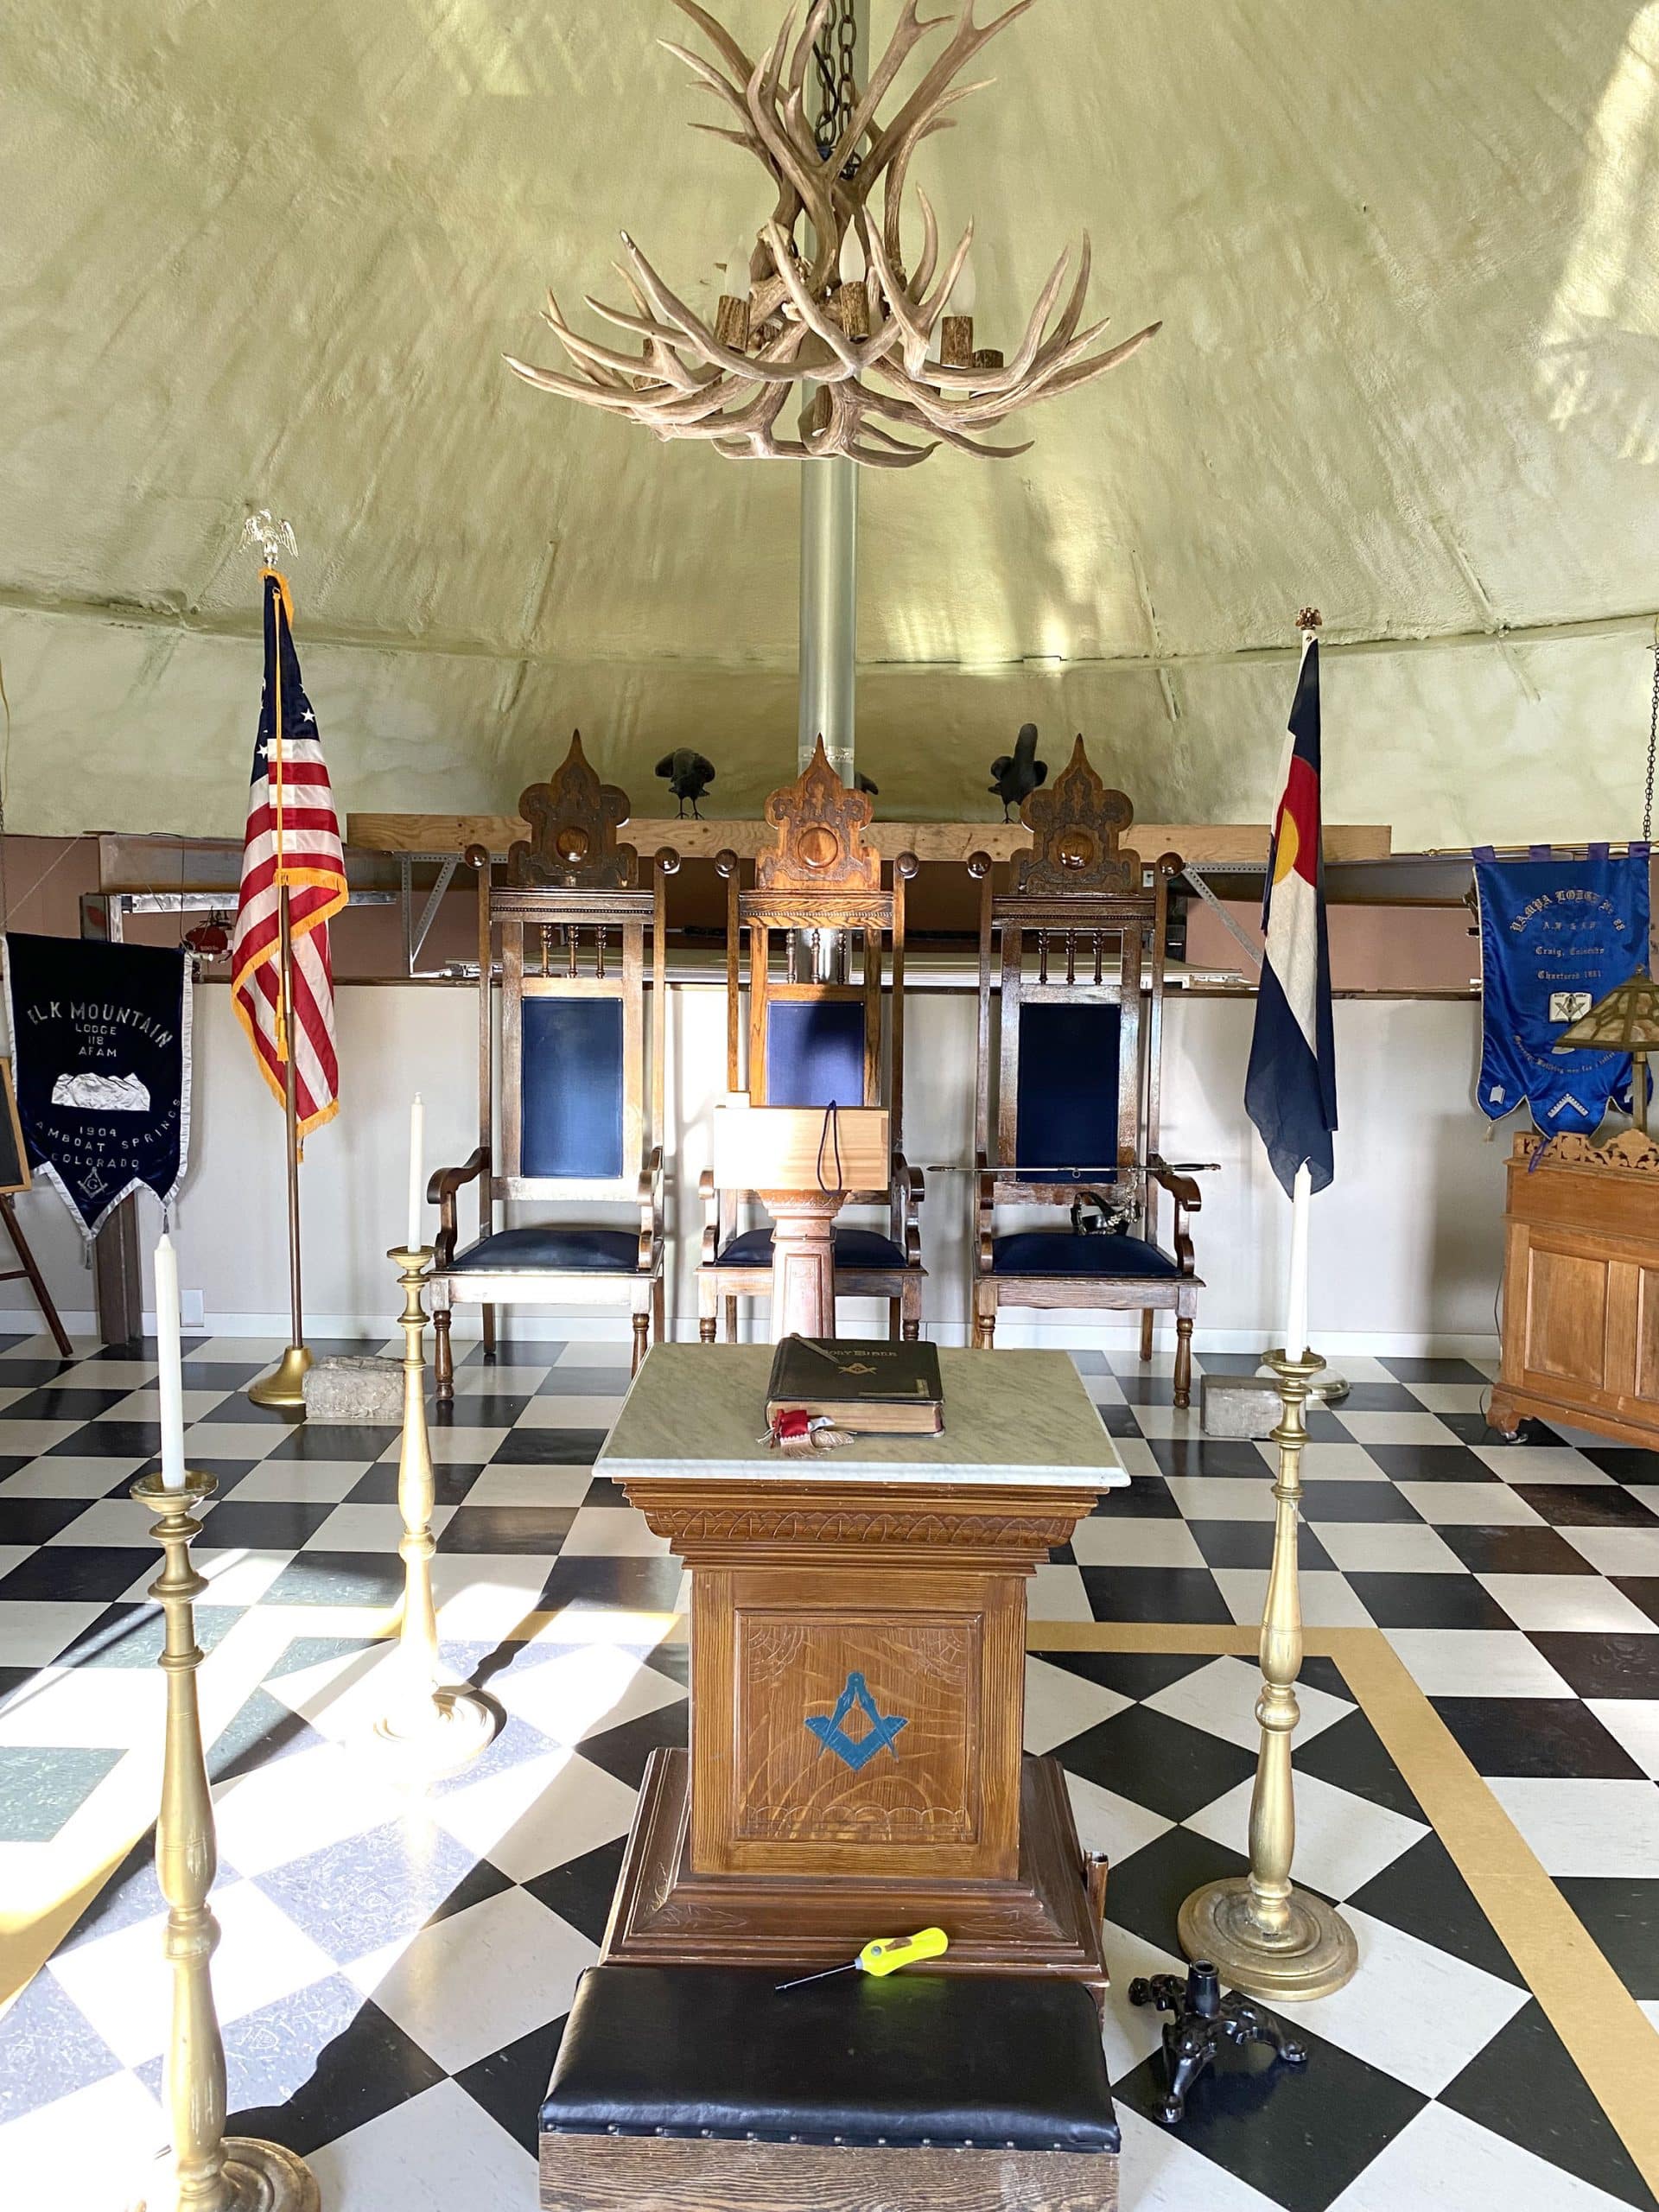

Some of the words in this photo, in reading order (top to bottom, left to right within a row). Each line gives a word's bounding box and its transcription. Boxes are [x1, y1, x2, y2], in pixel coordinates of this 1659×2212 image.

[1613, 918, 1625, 931] 88
[27, 1001, 62, 1025] ELK
[70, 1001, 174, 1048] MOUNTAIN
[75, 1023, 117, 1035] LODGE
[88, 1036, 104, 1045] 118
[79, 1046, 117, 1057] AFAM
[35, 1121, 105, 1153] AMBOAT
[79, 1126, 117, 1137] 1904
[52, 1153, 139, 1168] COLORADO
